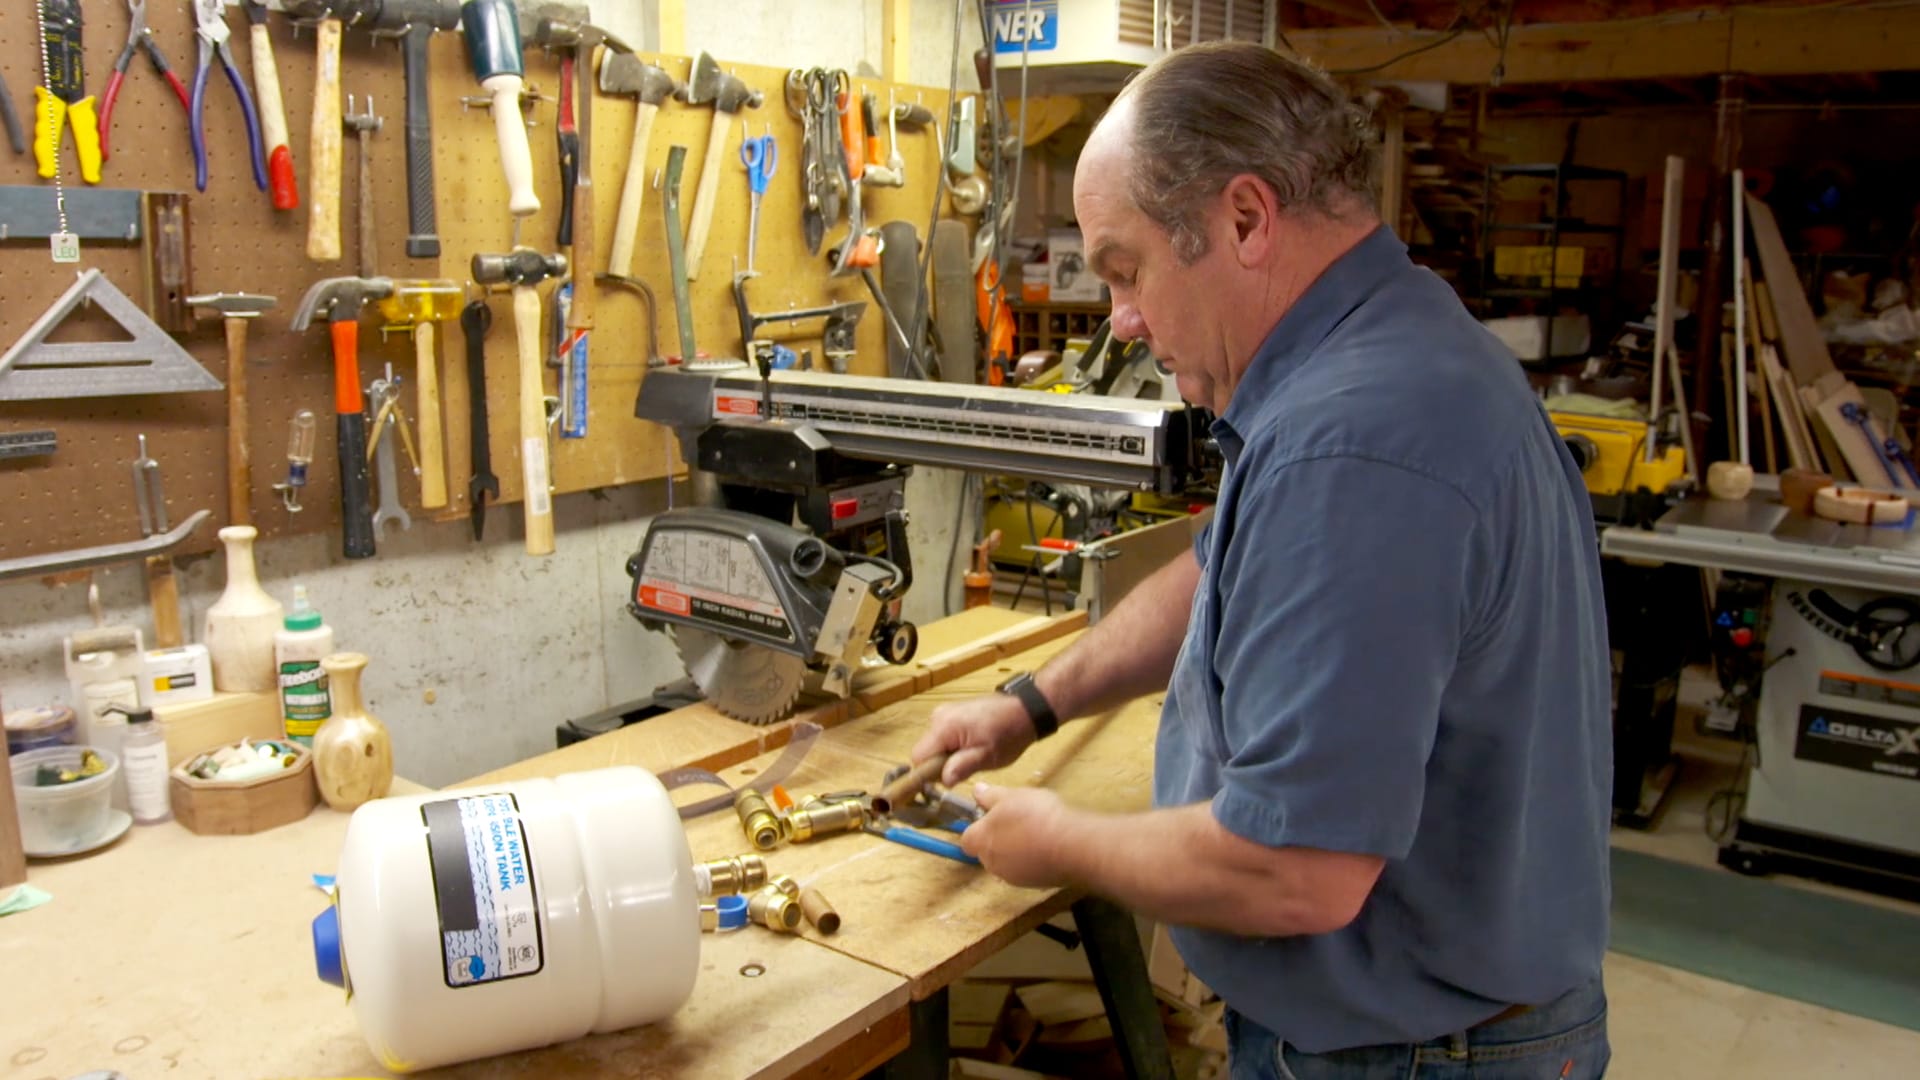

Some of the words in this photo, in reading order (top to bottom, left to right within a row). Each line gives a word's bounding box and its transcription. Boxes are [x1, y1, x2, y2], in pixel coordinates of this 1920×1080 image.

[54, 247, 77, 258] LED
[766, 615, 784, 629] SAW
[1828, 722, 1897, 745] DELTA
[483, 798, 505, 852] EXPSION
[496, 854, 512, 891] TANK
[499, 797, 514, 838] POTBLE
[508, 837, 525, 885] WATER
